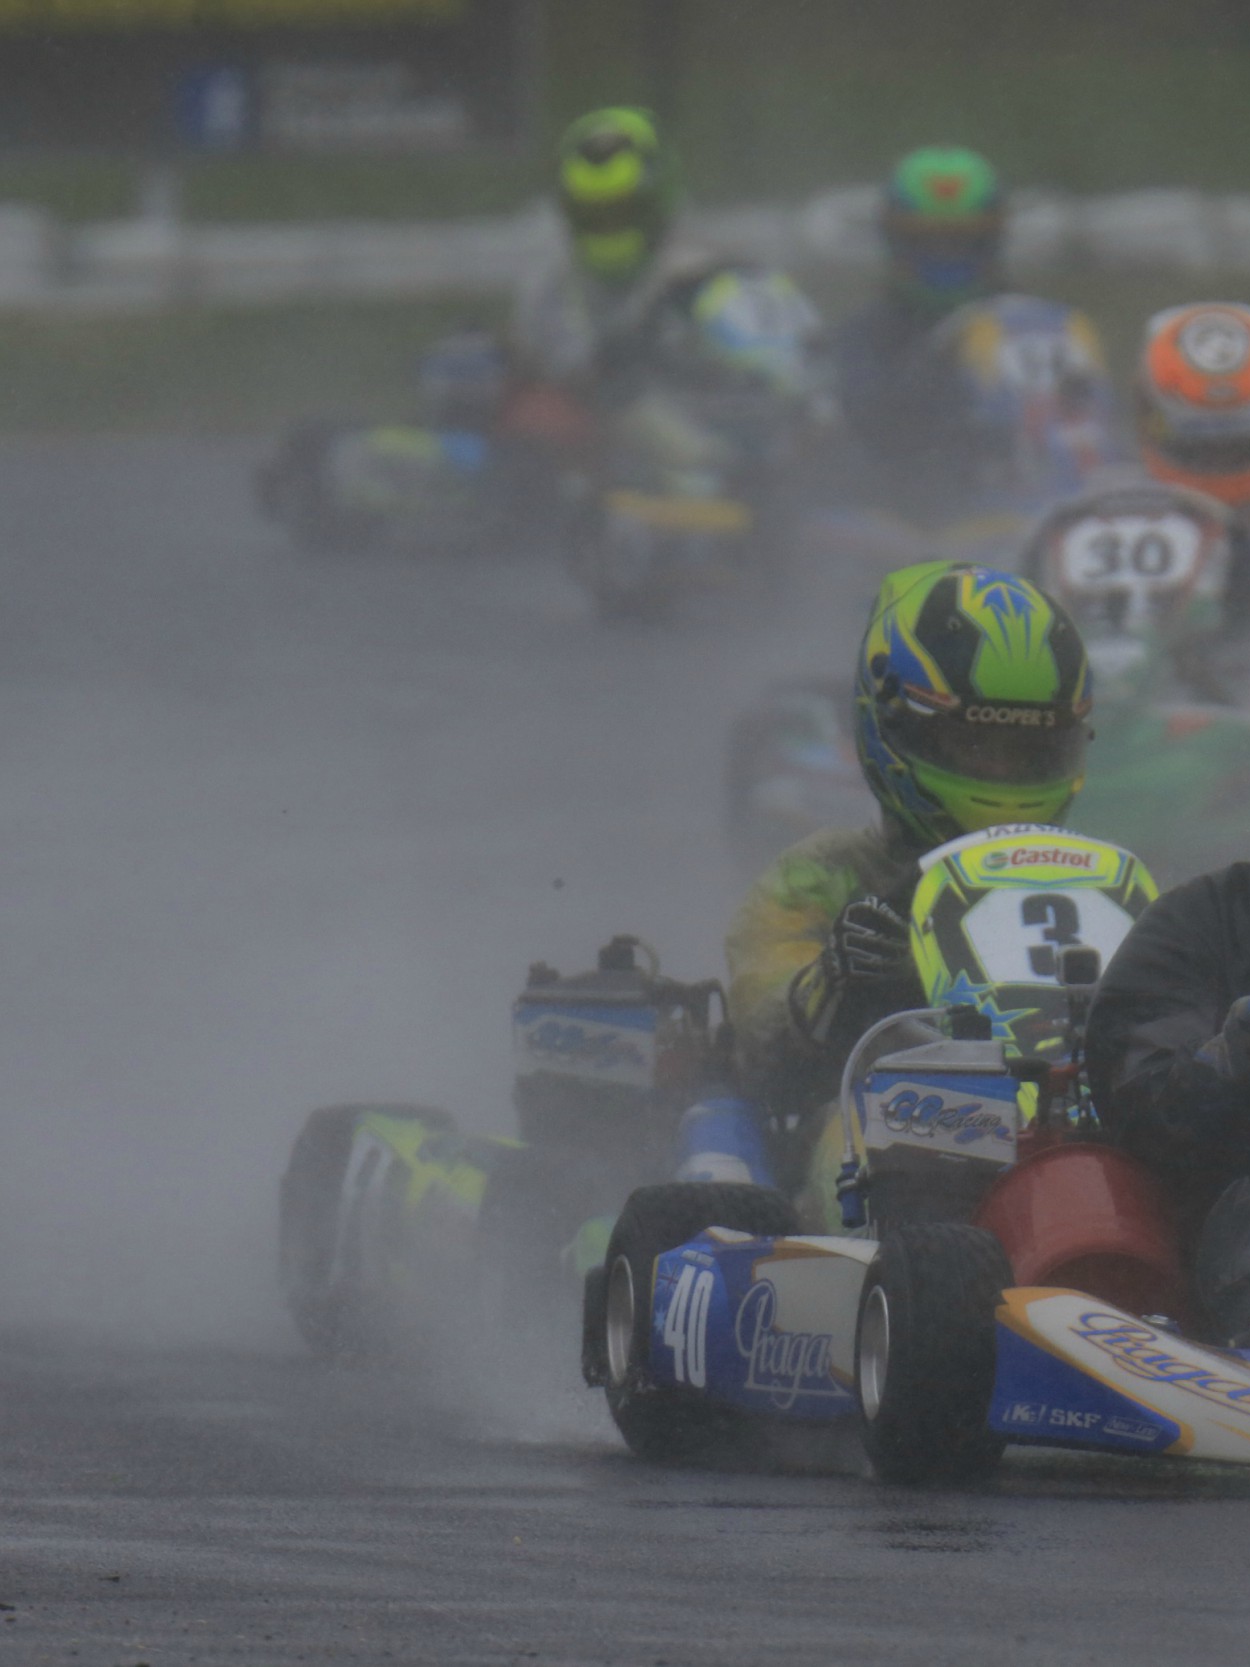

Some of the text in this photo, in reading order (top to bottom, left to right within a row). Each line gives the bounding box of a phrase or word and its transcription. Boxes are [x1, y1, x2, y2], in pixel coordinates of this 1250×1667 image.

[1011, 847, 1094, 869] Castrol
[1022, 894, 1080, 977] 3
[664, 1263, 715, 1389] 40
[736, 1280, 852, 1410] Praga
[1048, 1406, 1102, 1430] SKF
